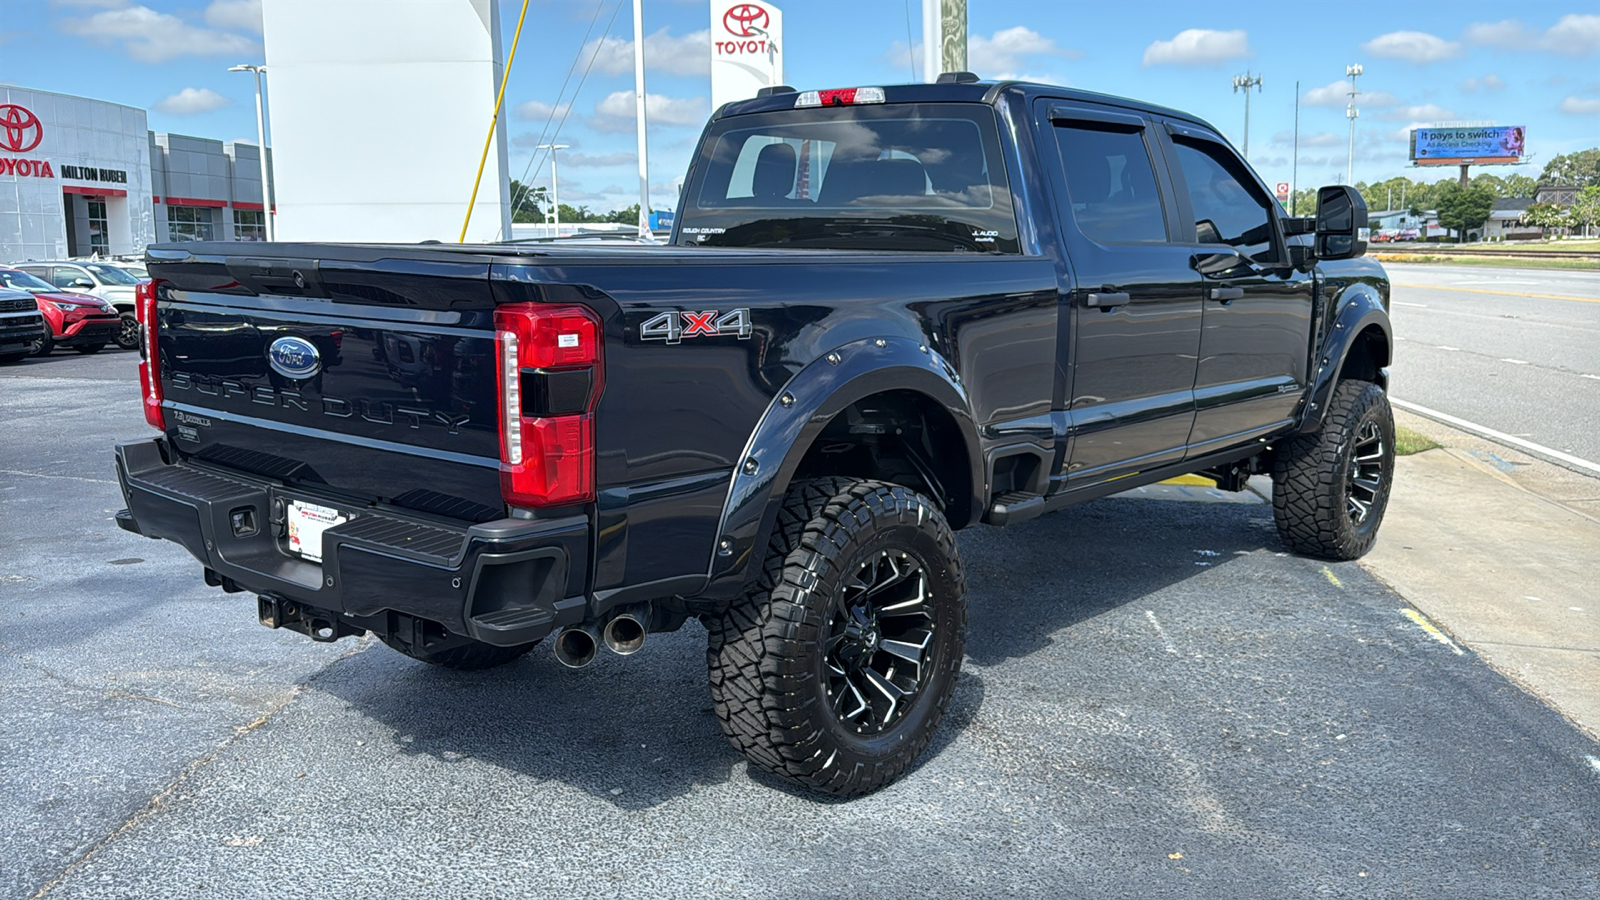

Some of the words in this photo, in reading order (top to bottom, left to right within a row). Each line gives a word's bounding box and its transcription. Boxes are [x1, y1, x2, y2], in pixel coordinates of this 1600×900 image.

[715, 40, 779, 55] TOYOTA
[1421, 132, 1427, 140] It
[1430, 132, 1453, 141] pays
[1456, 131, 1465, 139] to
[1467, 129, 1499, 139] switch
[61, 165, 98, 181] MILTON
[99, 168, 127, 184] RUBEN
[701, 227, 726, 235] COUNTRY
[279, 343, 305, 366] Ford
[172, 373, 308, 411] SUPER
[322, 397, 470, 434] DUTY
